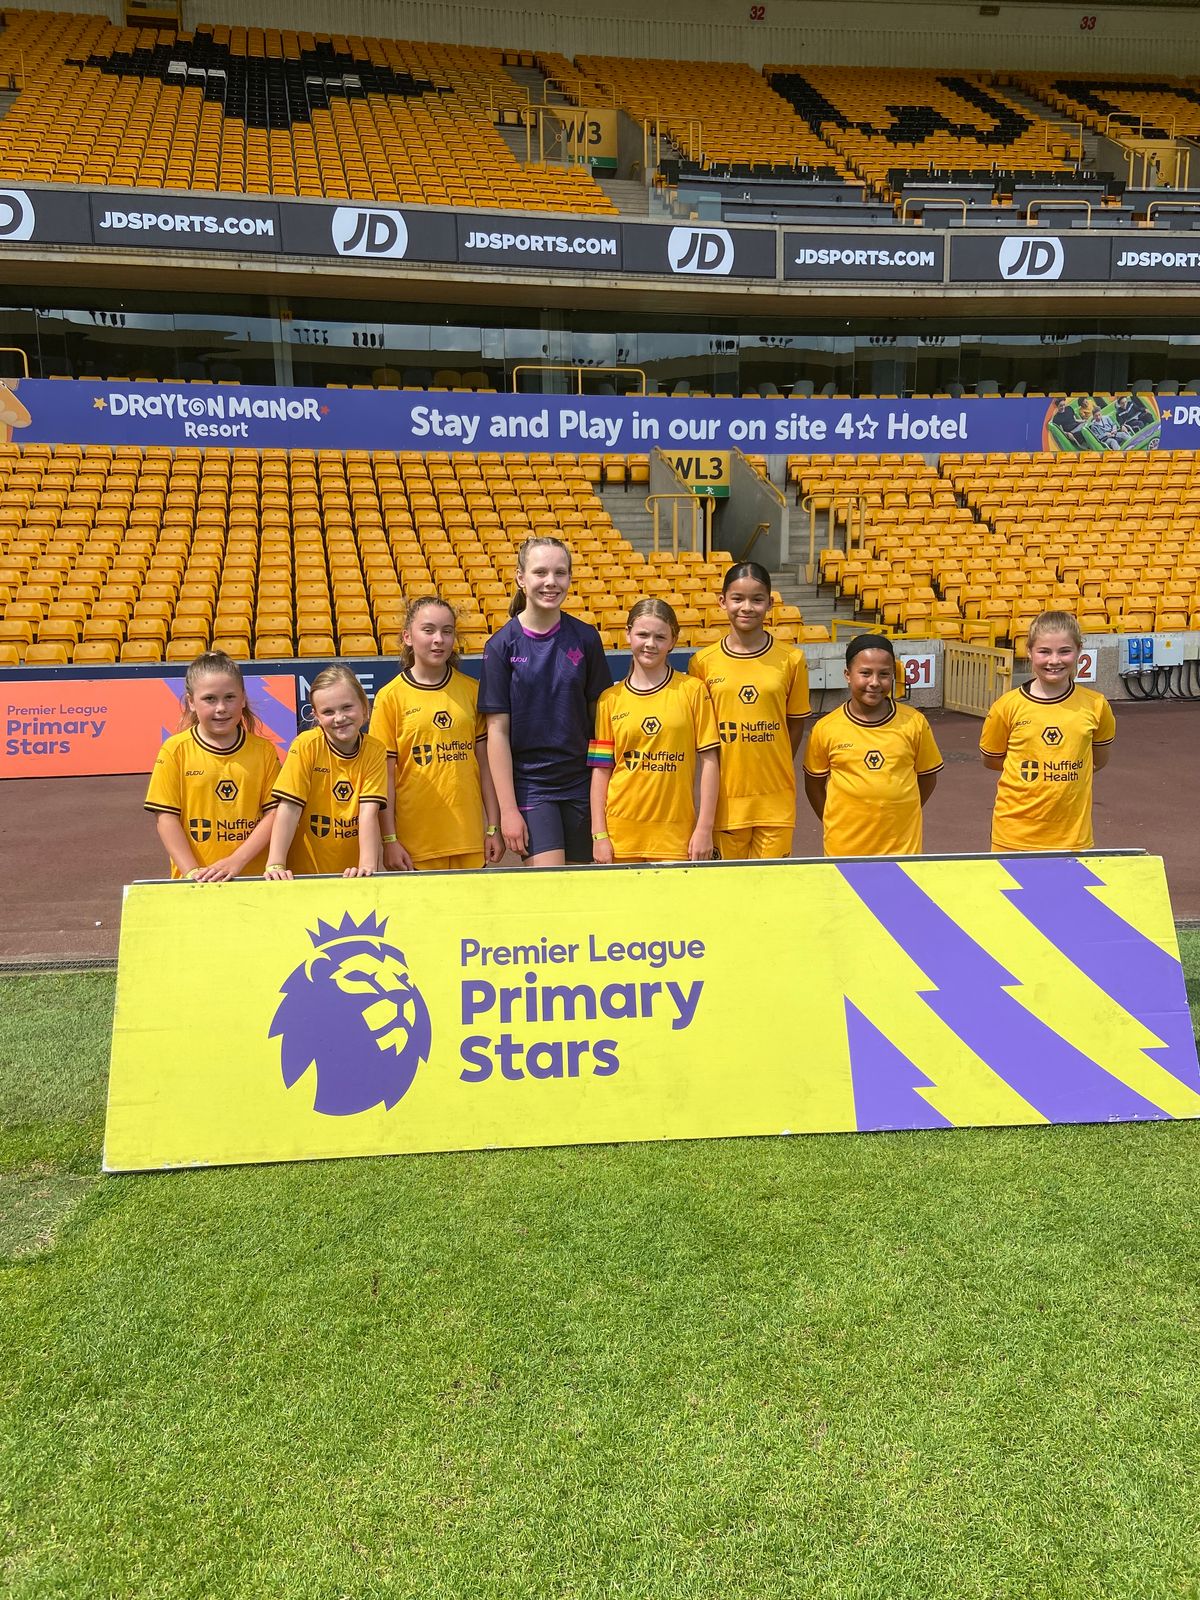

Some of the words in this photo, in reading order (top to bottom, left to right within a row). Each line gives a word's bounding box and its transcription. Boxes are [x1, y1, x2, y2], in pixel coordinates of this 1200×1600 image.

[749, 6, 766, 20] 32
[1080, 16, 1097, 30] 33
[560, 119, 602, 145] W3
[99, 211, 275, 236] JDSPORTS.COM
[343, 212, 398, 253] JD
[464, 231, 618, 256] JDSPORTS.COM
[677, 232, 726, 270] JD
[794, 248, 935, 267] JDSPORTS.COM
[1007, 240, 1056, 276] JD
[184, 421, 249, 439] Resort
[410, 405, 481, 445] Stay
[489, 409, 549, 439] and
[559, 410, 623, 447] Play
[632, 411, 660, 440] in
[668, 417, 721, 441] our
[728, 418, 767, 441] on
[774, 412, 827, 441] site
[887, 412, 968, 441] Hotel
[666, 456, 723, 480] WL3
[905, 658, 931, 684] 31
[1077, 653, 1092, 679] 2
[7, 704, 57, 716] Premier
[60, 703, 108, 717] League
[7, 717, 106, 738] Primary
[740, 720, 780, 732] Nuffield
[436, 740, 473, 752] Nuffield
[741, 732, 775, 743] Health
[6, 738, 71, 756] Stars
[437, 752, 468, 763] Health
[642, 751, 685, 762] Nuffield
[1043, 759, 1084, 771] Nuffield
[641, 761, 677, 772] Health
[1043, 771, 1079, 782] Health
[217, 818, 261, 830] Nuffiel
[334, 815, 359, 828] Nuff
[334, 828, 359, 839] Hea
[460, 936, 580, 967] Premier
[588, 934, 706, 969] League
[461, 971, 705, 1031] Primary
[459, 1033, 621, 1083] Stars
